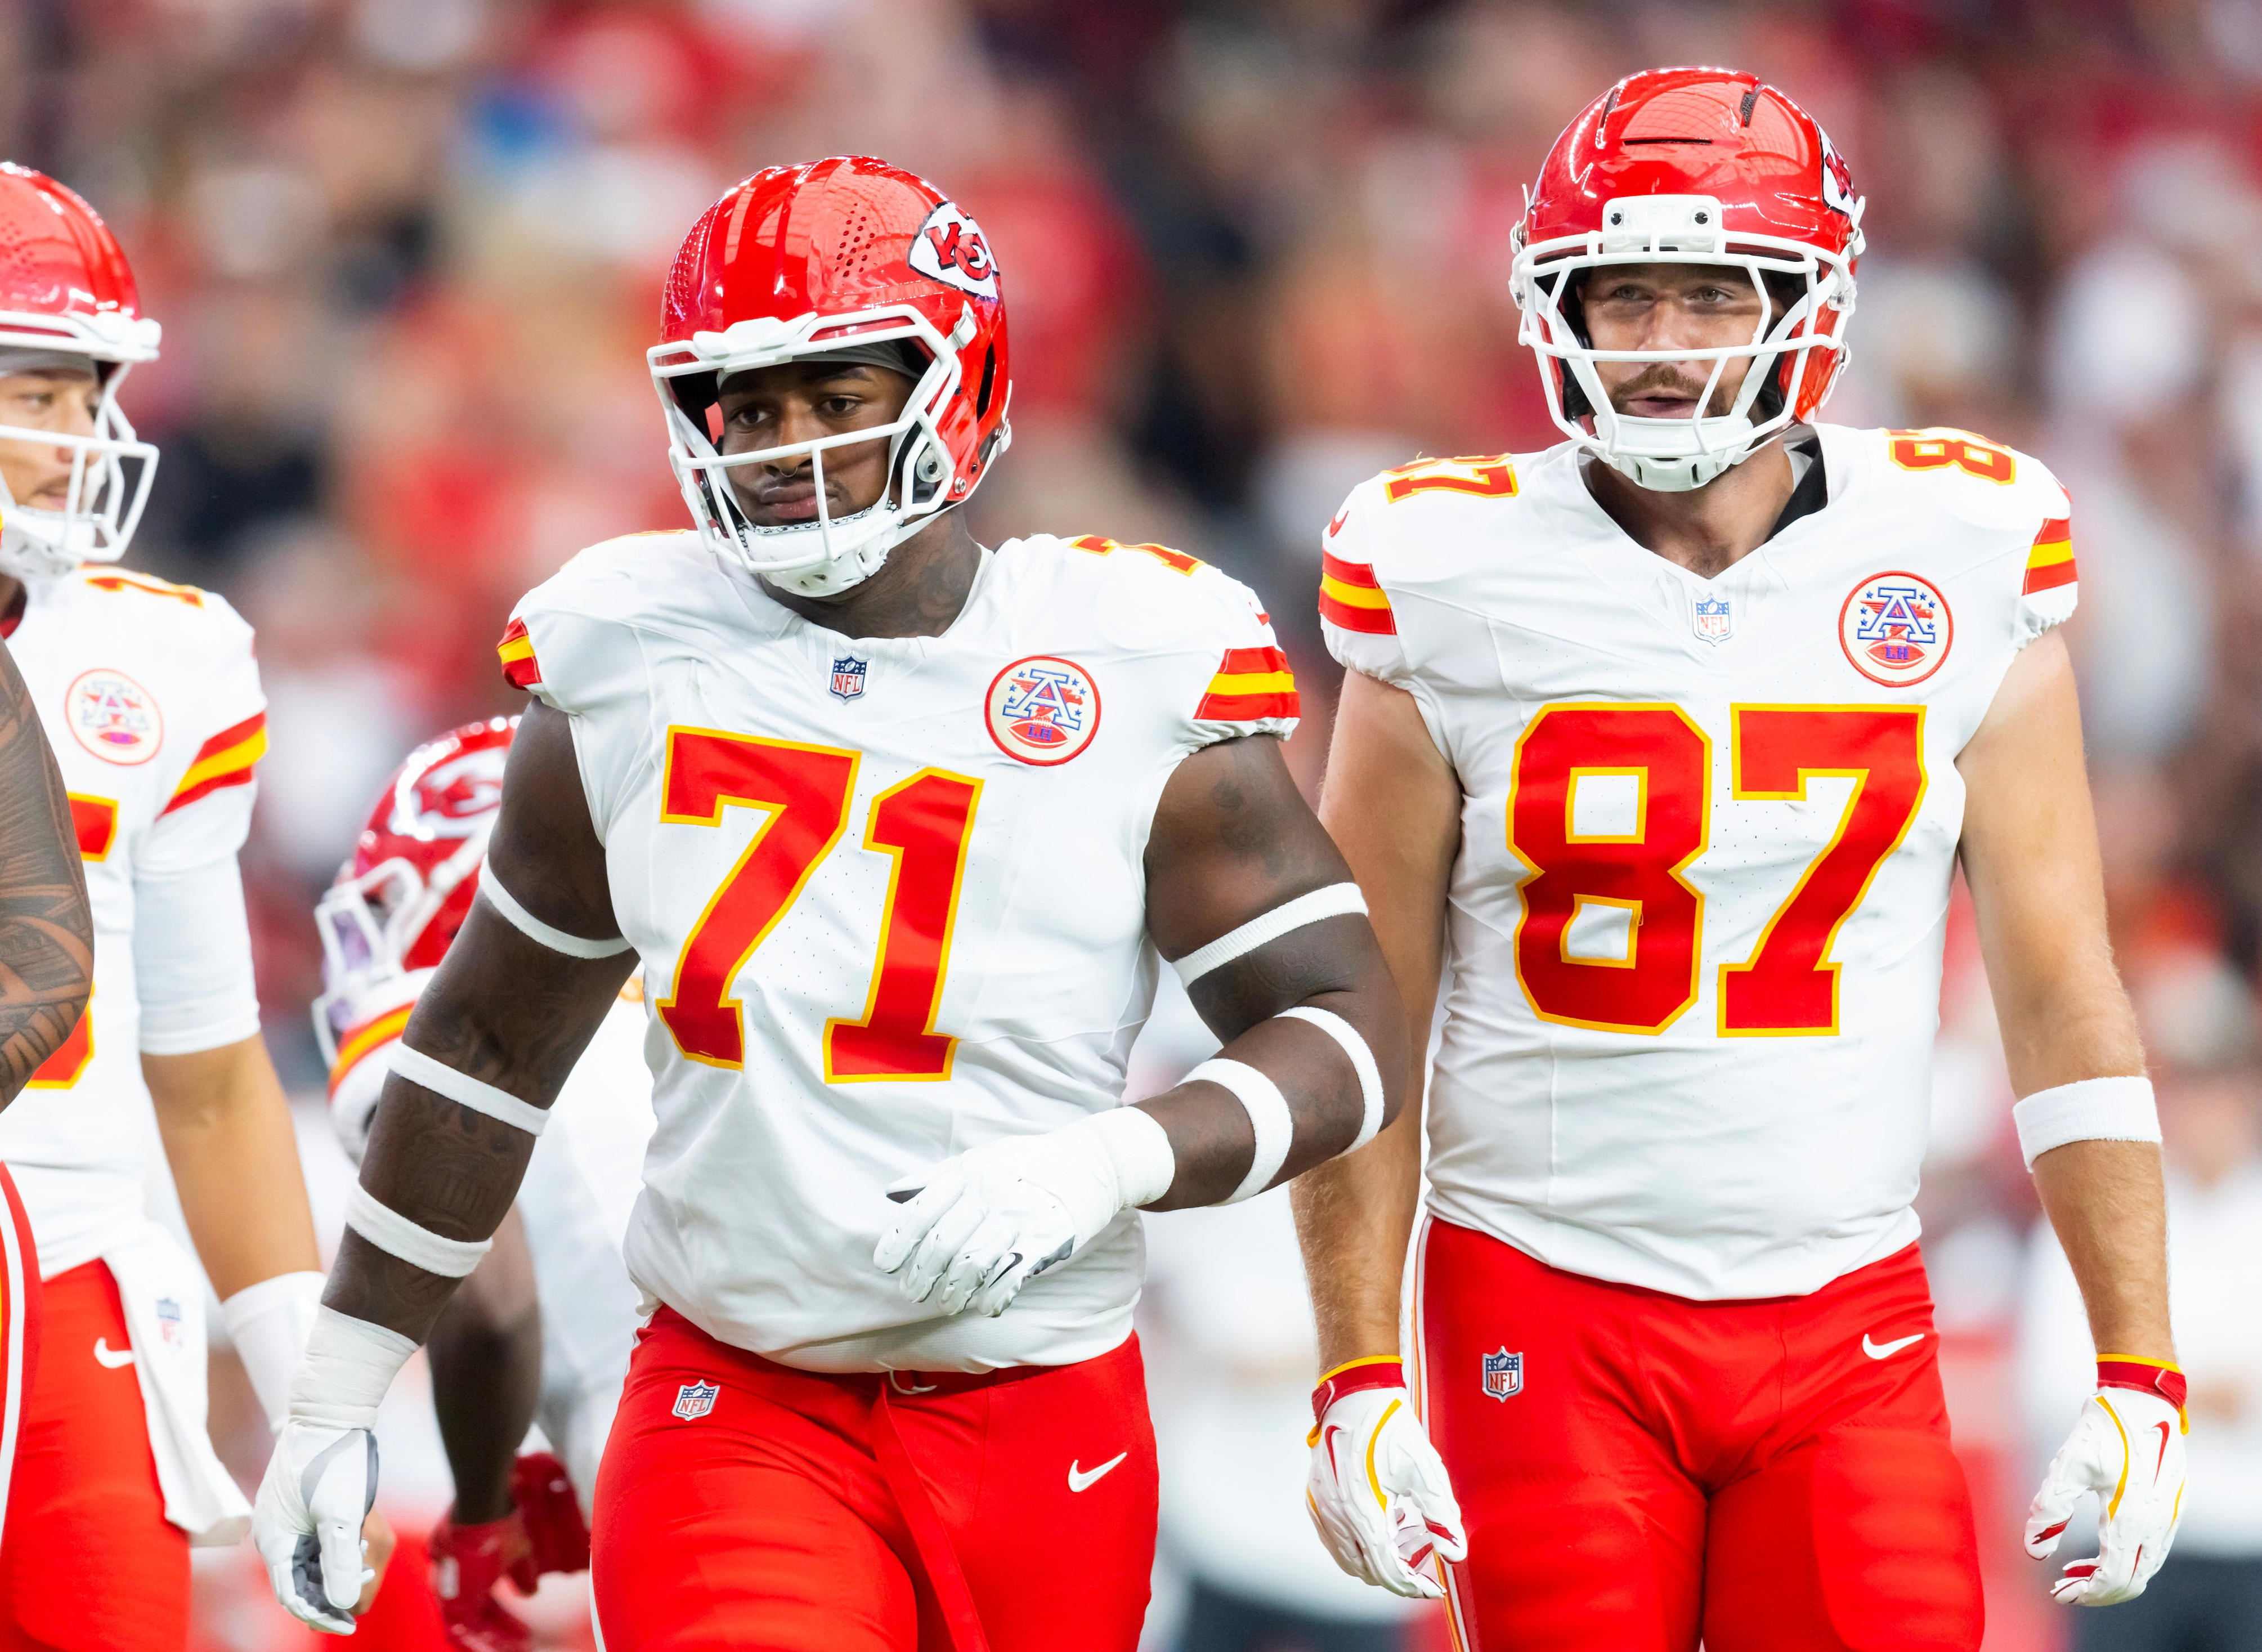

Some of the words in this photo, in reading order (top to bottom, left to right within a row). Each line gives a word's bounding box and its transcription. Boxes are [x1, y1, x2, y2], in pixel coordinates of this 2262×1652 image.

[924, 221, 992, 281] KC
[1381, 452, 1520, 505] 7
[1878, 427, 2016, 486] 8
[1700, 616, 1727, 635] NFL
[1857, 587, 1936, 643] A
[1885, 646, 1909, 660] LH
[834, 674, 860, 694] NFL
[1002, 668, 1081, 731] A
[1027, 724, 1053, 741] LH
[1506, 701, 1929, 1038] 87
[655, 724, 985, 1084] 71
[679, 1399, 706, 1413] NFL
[1489, 1372, 1516, 1392] NFL
